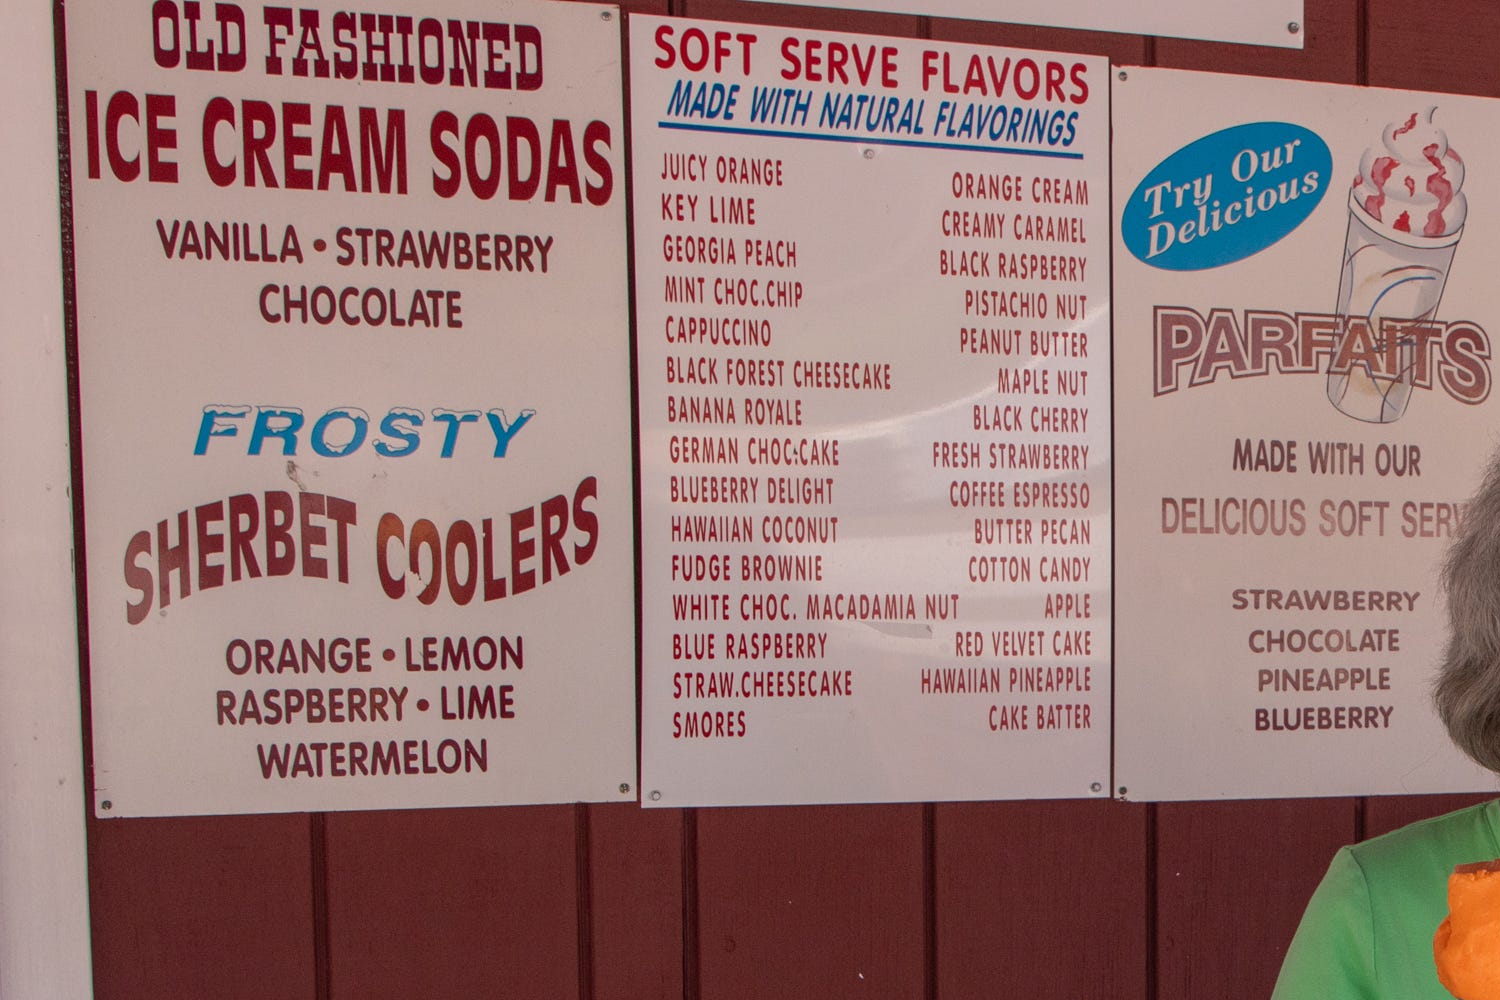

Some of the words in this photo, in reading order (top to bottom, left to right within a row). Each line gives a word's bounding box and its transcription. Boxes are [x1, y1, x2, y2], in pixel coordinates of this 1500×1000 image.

[152, 0, 246, 72] OLD
[264, 6, 543, 91] FASHIONED
[655, 25, 757, 76] SOFT
[781, 37, 898, 88] SERVE
[919, 50, 1088, 105] FLAVORS
[667, 80, 740, 120] MADE
[751, 86, 812, 126] WITH
[819, 92, 924, 134] NATURAL
[935, 102, 1078, 148] FLAVORINGS
[85, 90, 178, 183] ICE
[202, 97, 407, 194] CREAM
[430, 111, 613, 206] SODAS
[662, 153, 707, 181] JUICY
[717, 156, 782, 186] ORANGE
[1143, 173, 1213, 219] Try
[1231, 138, 1302, 183] Our
[952, 172, 1022, 201] ORANGE
[1032, 177, 1088, 205] CREAM
[662, 193, 698, 222] KEY
[710, 196, 755, 225] LIME
[1145, 168, 1320, 260] Delicious
[942, 210, 1005, 238] CREAMY
[1014, 214, 1086, 243] CARAMEL
[156, 219, 303, 264] VANILLA
[336, 227, 553, 273] STRAWBERRY
[663, 234, 736, 264] GEORGIA
[746, 239, 796, 267] PEACH
[940, 250, 989, 277] BLACK
[999, 253, 1086, 282] RASPBERRY
[259, 284, 462, 328] CHOCOLATE
[966, 290, 1047, 319] PISTACHIO
[1057, 294, 1086, 320] NUT
[666, 316, 771, 346] CAPPUCCINO
[961, 328, 1021, 355] PEANUT
[1031, 331, 1087, 357] BUTTER
[1153, 305, 1492, 406] PARFAITS
[667, 356, 717, 384] BLACK
[727, 359, 784, 387] FOREST
[794, 361, 890, 390] CHEESECAKE
[668, 396, 735, 424] BANANA
[745, 398, 801, 425] ROYALE
[974, 405, 1022, 431] BLACK
[1031, 406, 1088, 432] CHERRY
[194, 404, 536, 458] FROSTY
[933, 442, 980, 468] FRESH
[990, 443, 1088, 470] STRAWBERRY
[1233, 438, 1297, 473] MADE
[1308, 441, 1363, 475] WITH
[1375, 444, 1420, 477] OUR
[671, 476, 758, 503] BLUEBERRY
[768, 477, 833, 504] DELIGHT
[950, 481, 1004, 507] COFFEE
[1014, 482, 1089, 508] ESPRESSO
[672, 516, 752, 542] HAWAIIAN
[762, 516, 838, 543] COCONUT
[1162, 497, 1306, 536] DELICIOUS
[1319, 499, 1390, 537] SOFT
[124, 491, 357, 625] SHERBET
[377, 476, 598, 605] COOLERS
[672, 554, 730, 581] FUDGE
[742, 555, 822, 581] BROWNIE
[969, 556, 1030, 582] COTTON
[1040, 557, 1090, 582] CANDY
[673, 595, 729, 620] WHITE
[741, 594, 796, 621] CHOC.
[807, 594, 915, 620] MACADAMIA
[926, 594, 959, 620] NUT
[1045, 594, 1090, 618] APPLE
[1232, 589, 1420, 611] STRAWBERRY
[226, 638, 371, 675] ORANGE
[406, 636, 523, 671] LEMON
[1249, 629, 1399, 653] CHOCOLATE
[922, 668, 1000, 694] HAWAIIAN
[1010, 667, 1090, 692] PINEAPPLE
[1259, 668, 1390, 692] PINEAPPLE
[217, 687, 408, 725] RASPBERRY
[441, 685, 515, 720] LIME
[1255, 706, 1393, 731] BLUEBERRY
[673, 711, 745, 738] SMORES
[257, 739, 487, 779] WATERMELON
